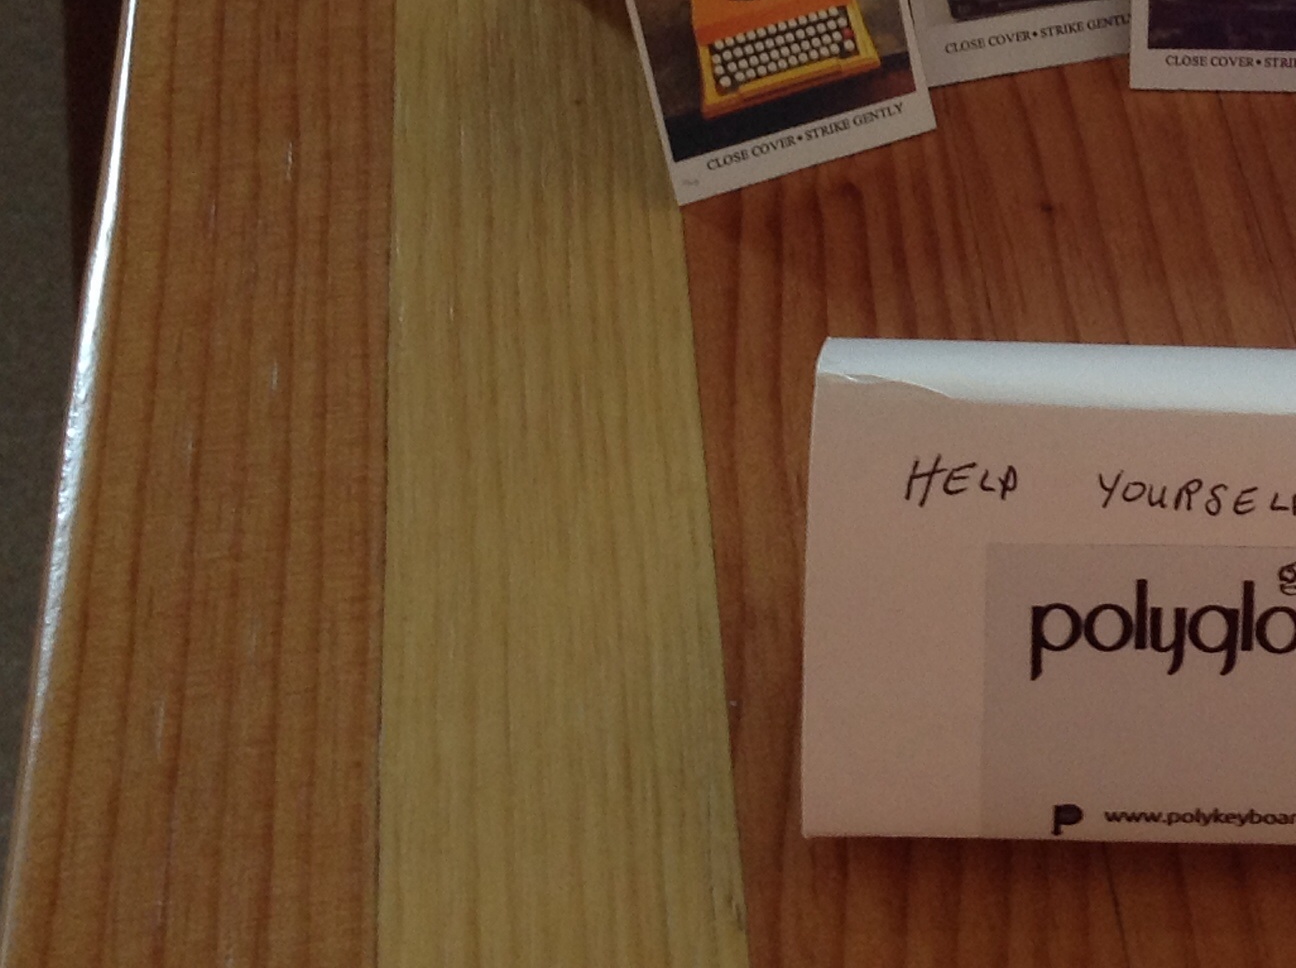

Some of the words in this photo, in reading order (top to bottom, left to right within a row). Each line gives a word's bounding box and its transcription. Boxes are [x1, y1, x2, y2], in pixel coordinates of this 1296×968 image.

[944, 38, 985, 54] CLOSE
[988, 31, 1031, 47] COVER
[1040, 21, 1084, 38] STRIKE
[1165, 55, 1208, 68] CLOSE
[1210, 56, 1254, 68] COVER
[706, 149, 750, 171] CLOSE
[751, 135, 797, 157] COVER
[805, 119, 851, 141] STRIKE
[852, 102, 904, 127] GENTLY
[904, 454, 1019, 508] HELP
